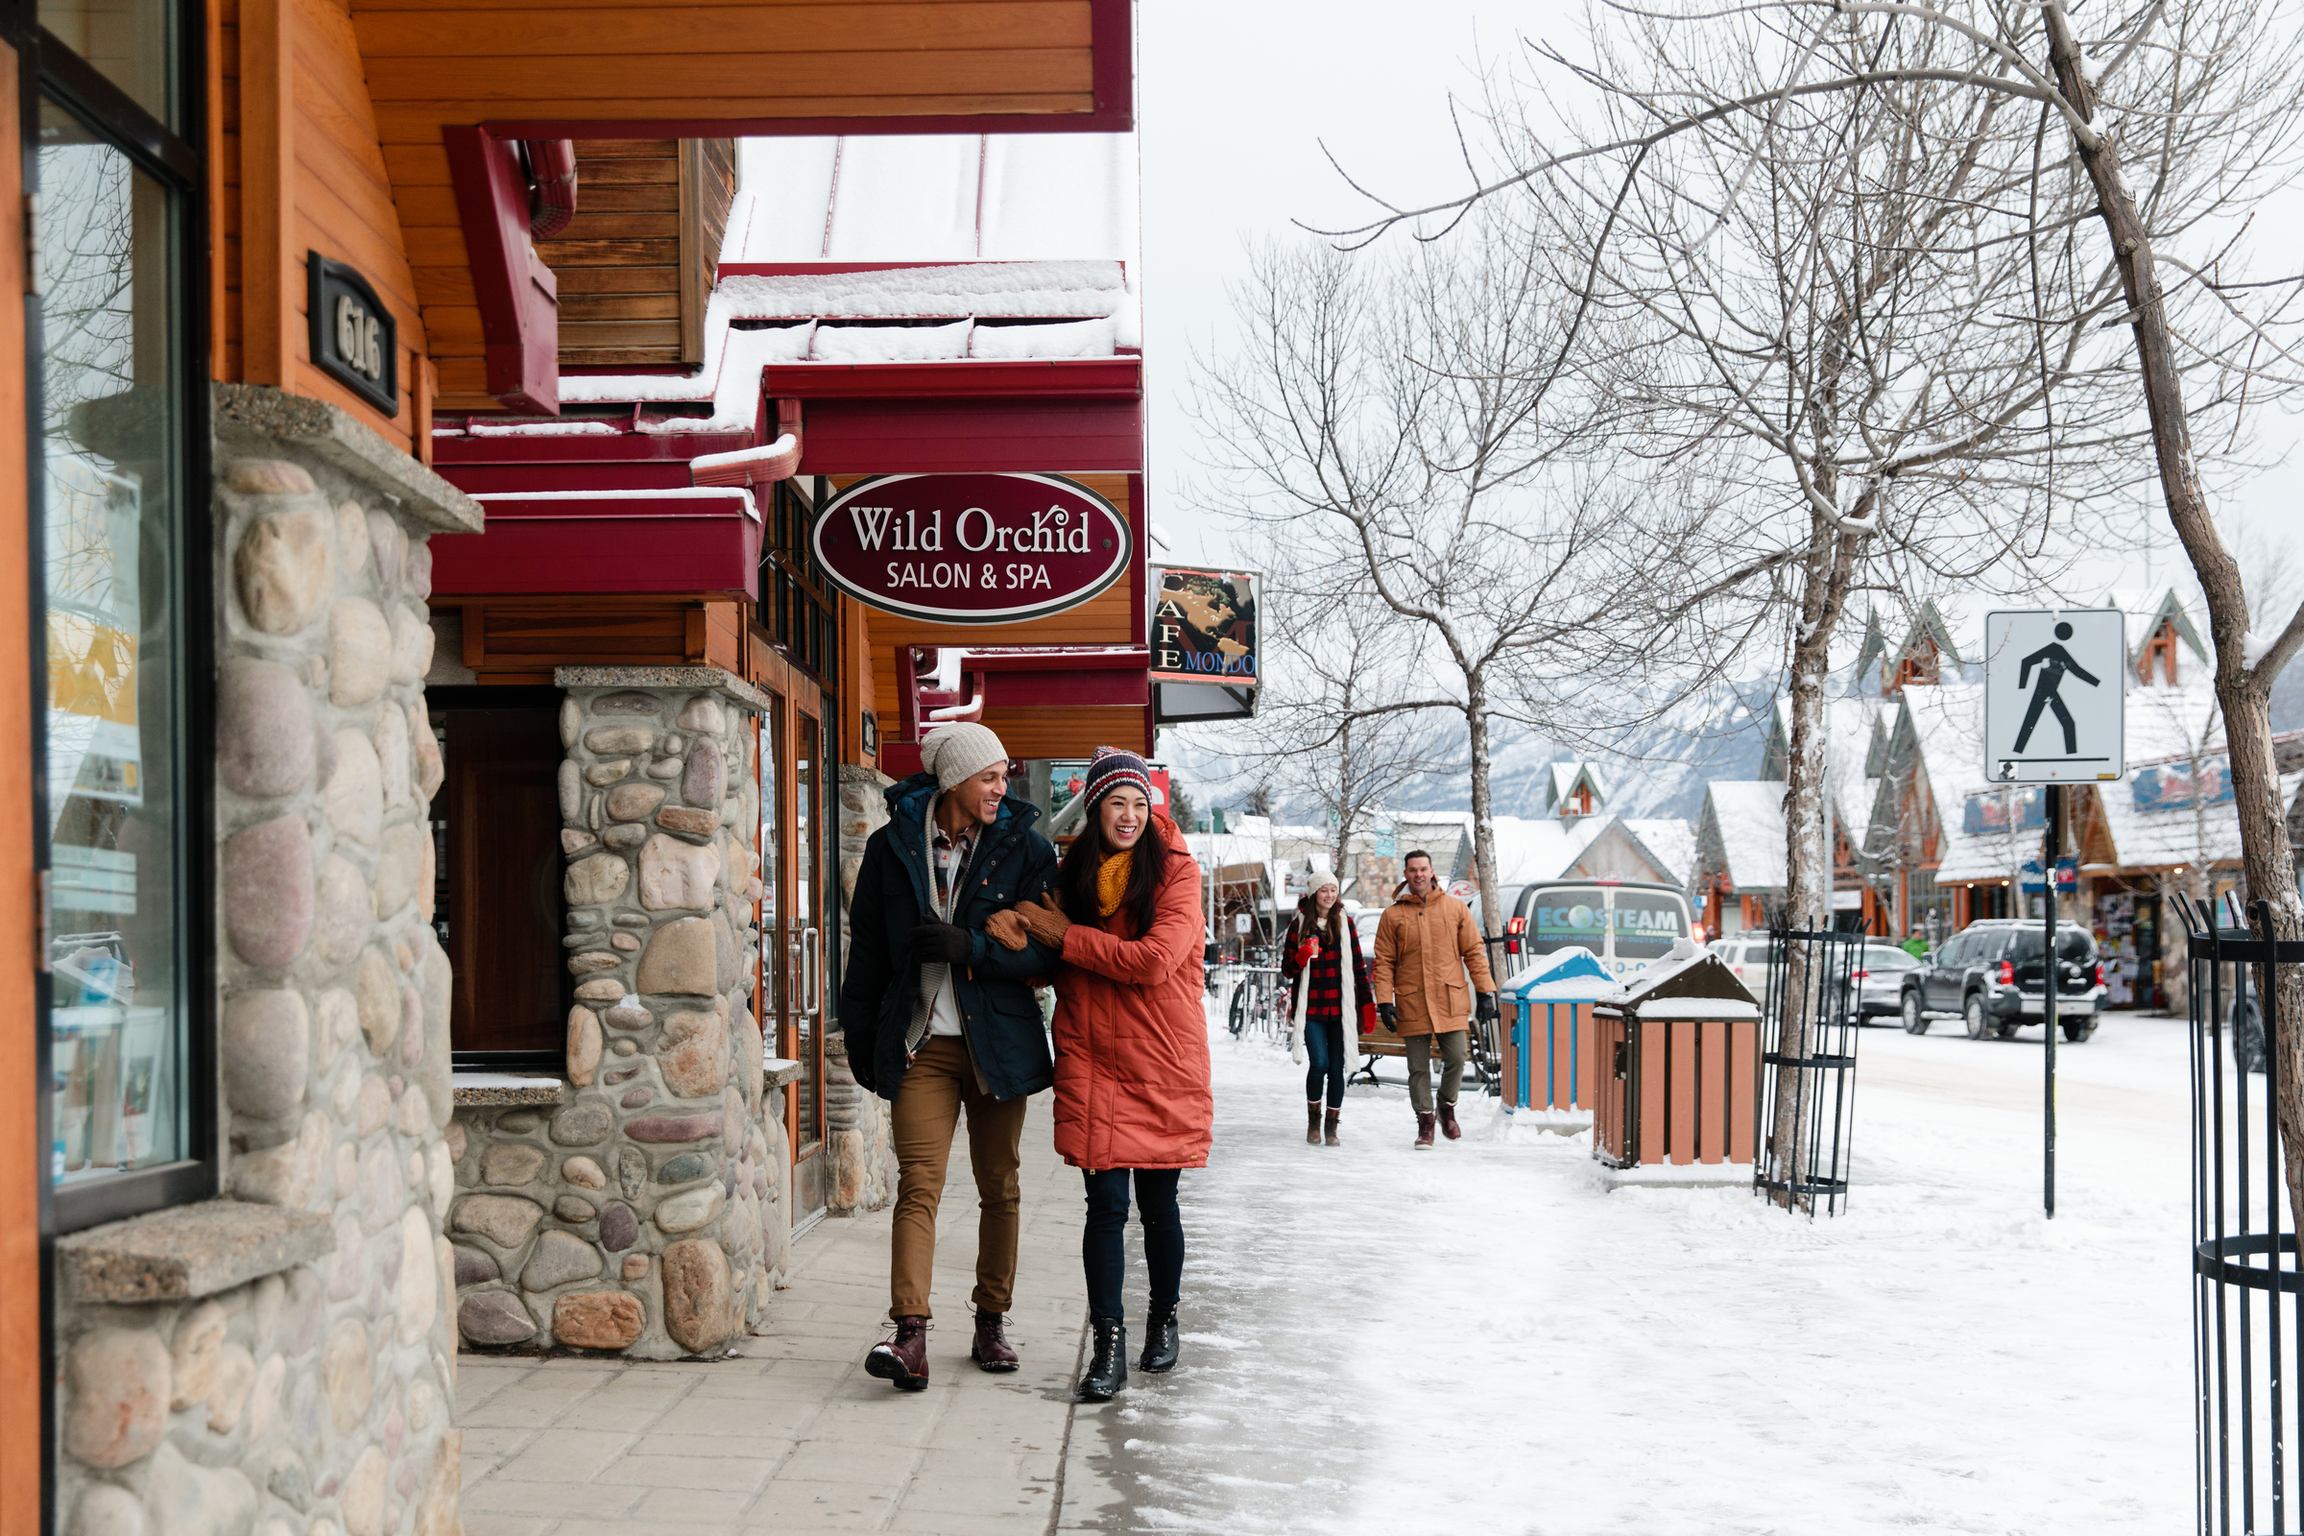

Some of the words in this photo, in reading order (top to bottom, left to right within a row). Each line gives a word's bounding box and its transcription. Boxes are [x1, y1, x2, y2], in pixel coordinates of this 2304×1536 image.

[337, 295, 381, 380] 616
[849, 507, 944, 551] Wild
[955, 504, 1091, 553] Orchid
[886, 562, 971, 588] SALON
[980, 563, 997, 589] &
[1005, 563, 1052, 589] SPA
[1155, 575, 1185, 669] CAFE
[1185, 651, 1256, 674] MONDO
